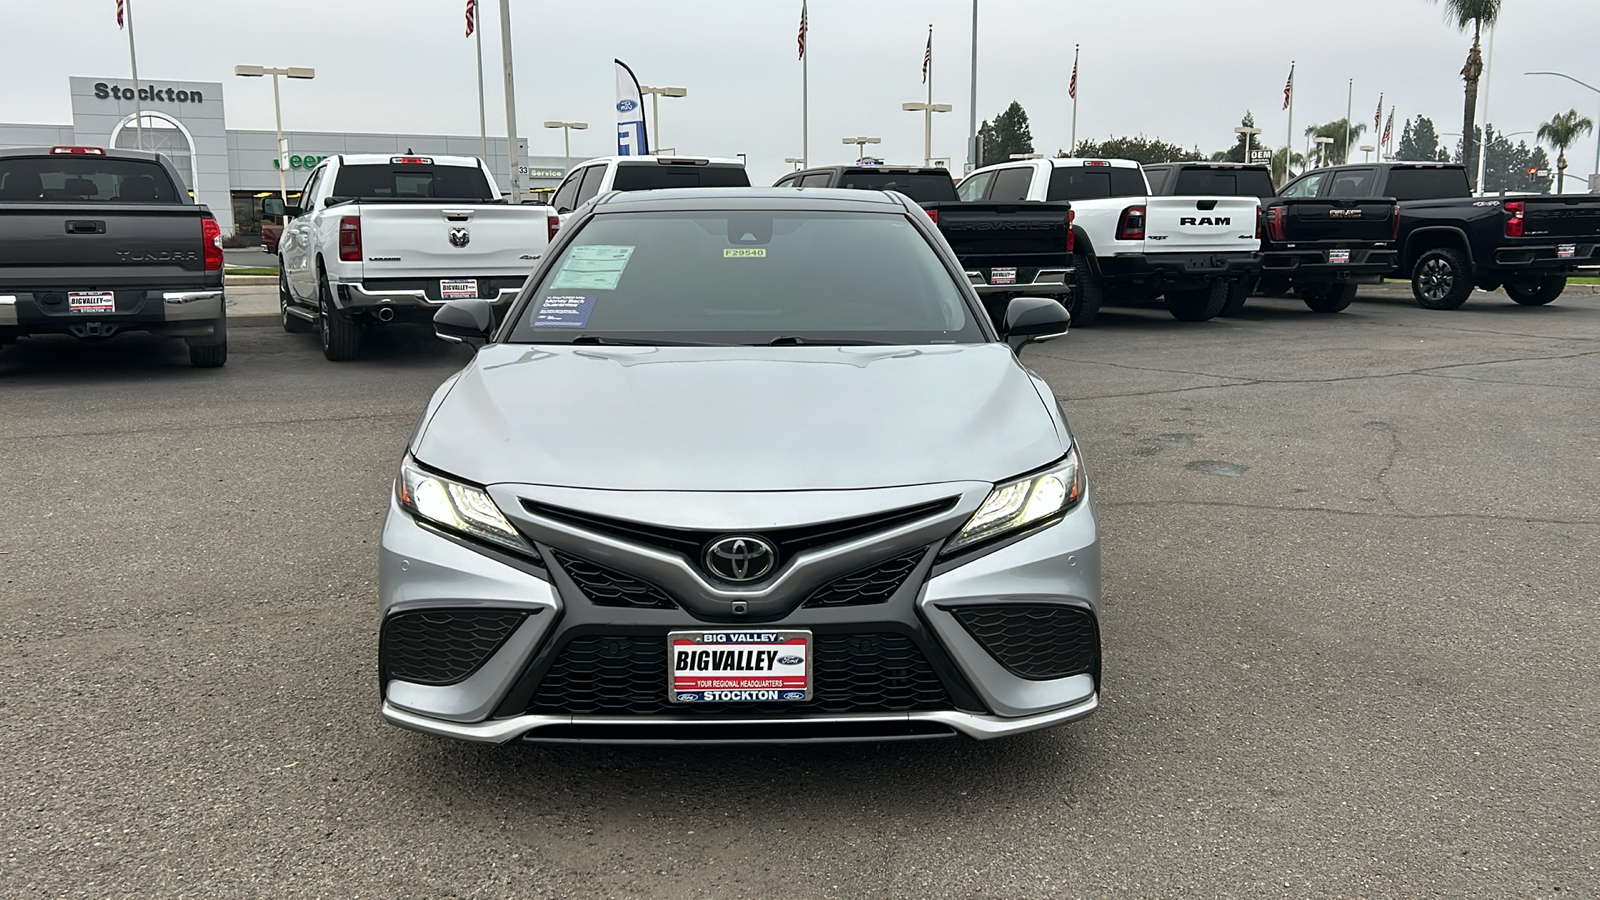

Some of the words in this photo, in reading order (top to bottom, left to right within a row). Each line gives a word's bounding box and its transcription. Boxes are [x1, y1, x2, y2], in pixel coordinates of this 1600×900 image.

[94, 82, 203, 103] Stockton
[1251, 151, 1271, 159] OEM
[519, 166, 528, 174] 33
[531, 169, 562, 177] Service
[1180, 217, 1231, 226] RAM
[116, 250, 198, 261] TUNDRA
[71, 297, 104, 305] BIGVALLEY
[703, 634, 727, 643] BIG
[730, 633, 777, 642] VALLEY
[675, 650, 779, 671] BIGVALLEY
[779, 656, 803, 665] Ford
[697, 680, 713, 688] YOUR
[713, 680, 739, 688] REGIONAL
[741, 680, 783, 688] HEADQUARTERS
[703, 690, 779, 701] STOCKTON
